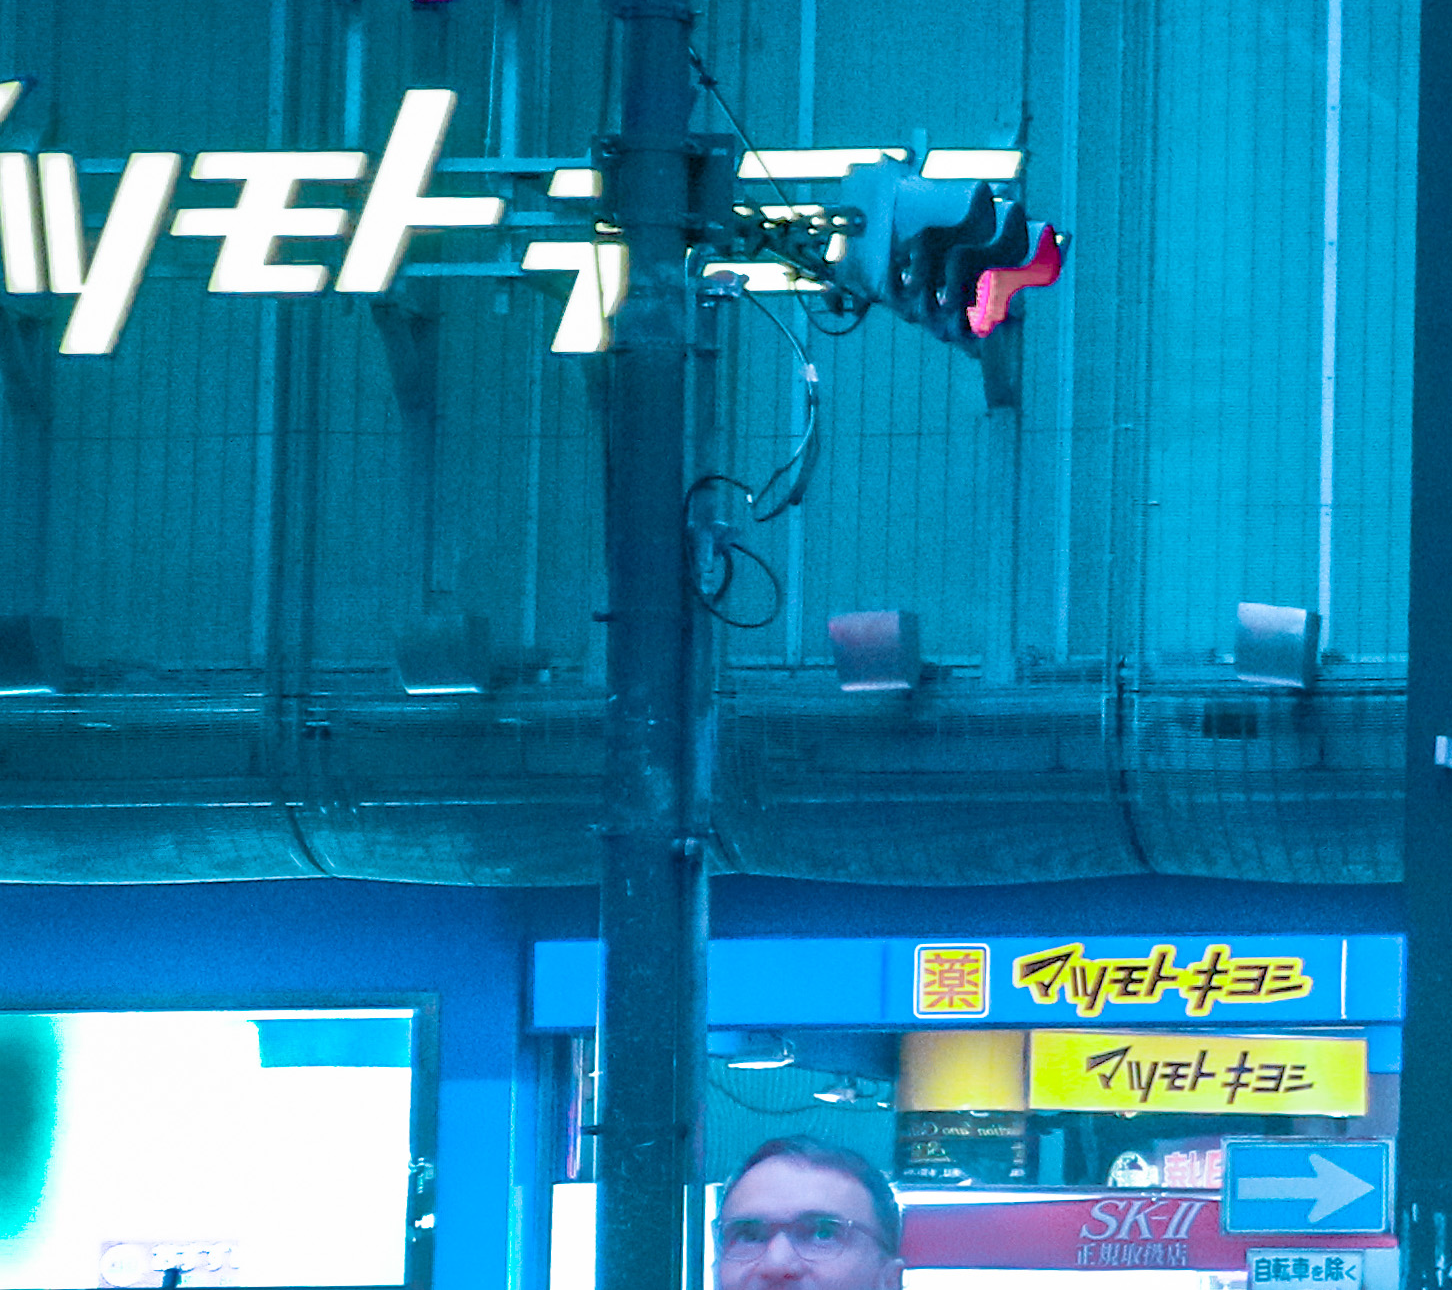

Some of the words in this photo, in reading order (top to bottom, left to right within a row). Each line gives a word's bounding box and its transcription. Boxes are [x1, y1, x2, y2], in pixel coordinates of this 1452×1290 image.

[925, 953, 979, 1009] 薬
[1017, 945, 1311, 1013] マツモトキヨシ
[1086, 1045, 1315, 1105] マツモトキヨシ
[1254, 1257, 1358, 1283] 自転車を除く
